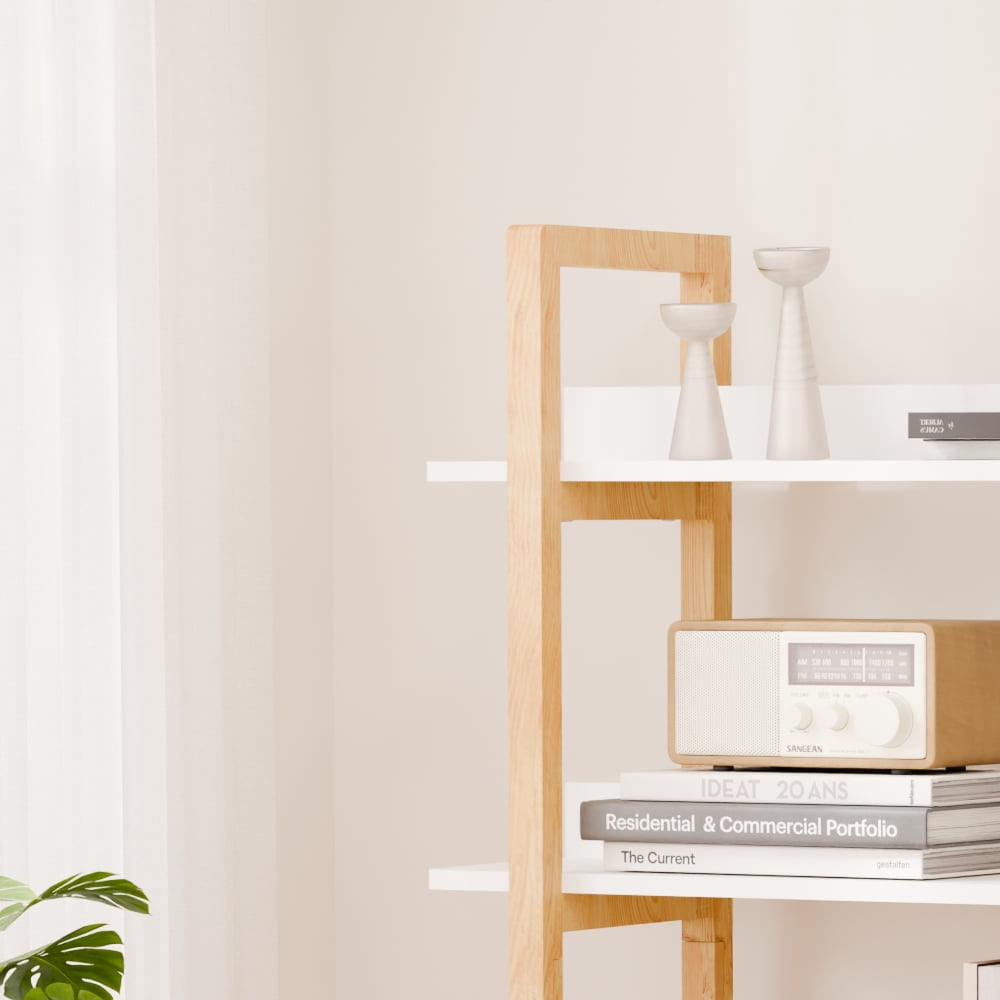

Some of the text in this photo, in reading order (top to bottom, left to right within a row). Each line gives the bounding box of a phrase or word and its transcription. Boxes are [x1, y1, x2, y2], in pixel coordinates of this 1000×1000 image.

[701, 778, 849, 801] IDEAT 20 ANS
[605, 813, 898, 838] Residential & Commercial Portfolio
[620, 850, 696, 866] The Current
